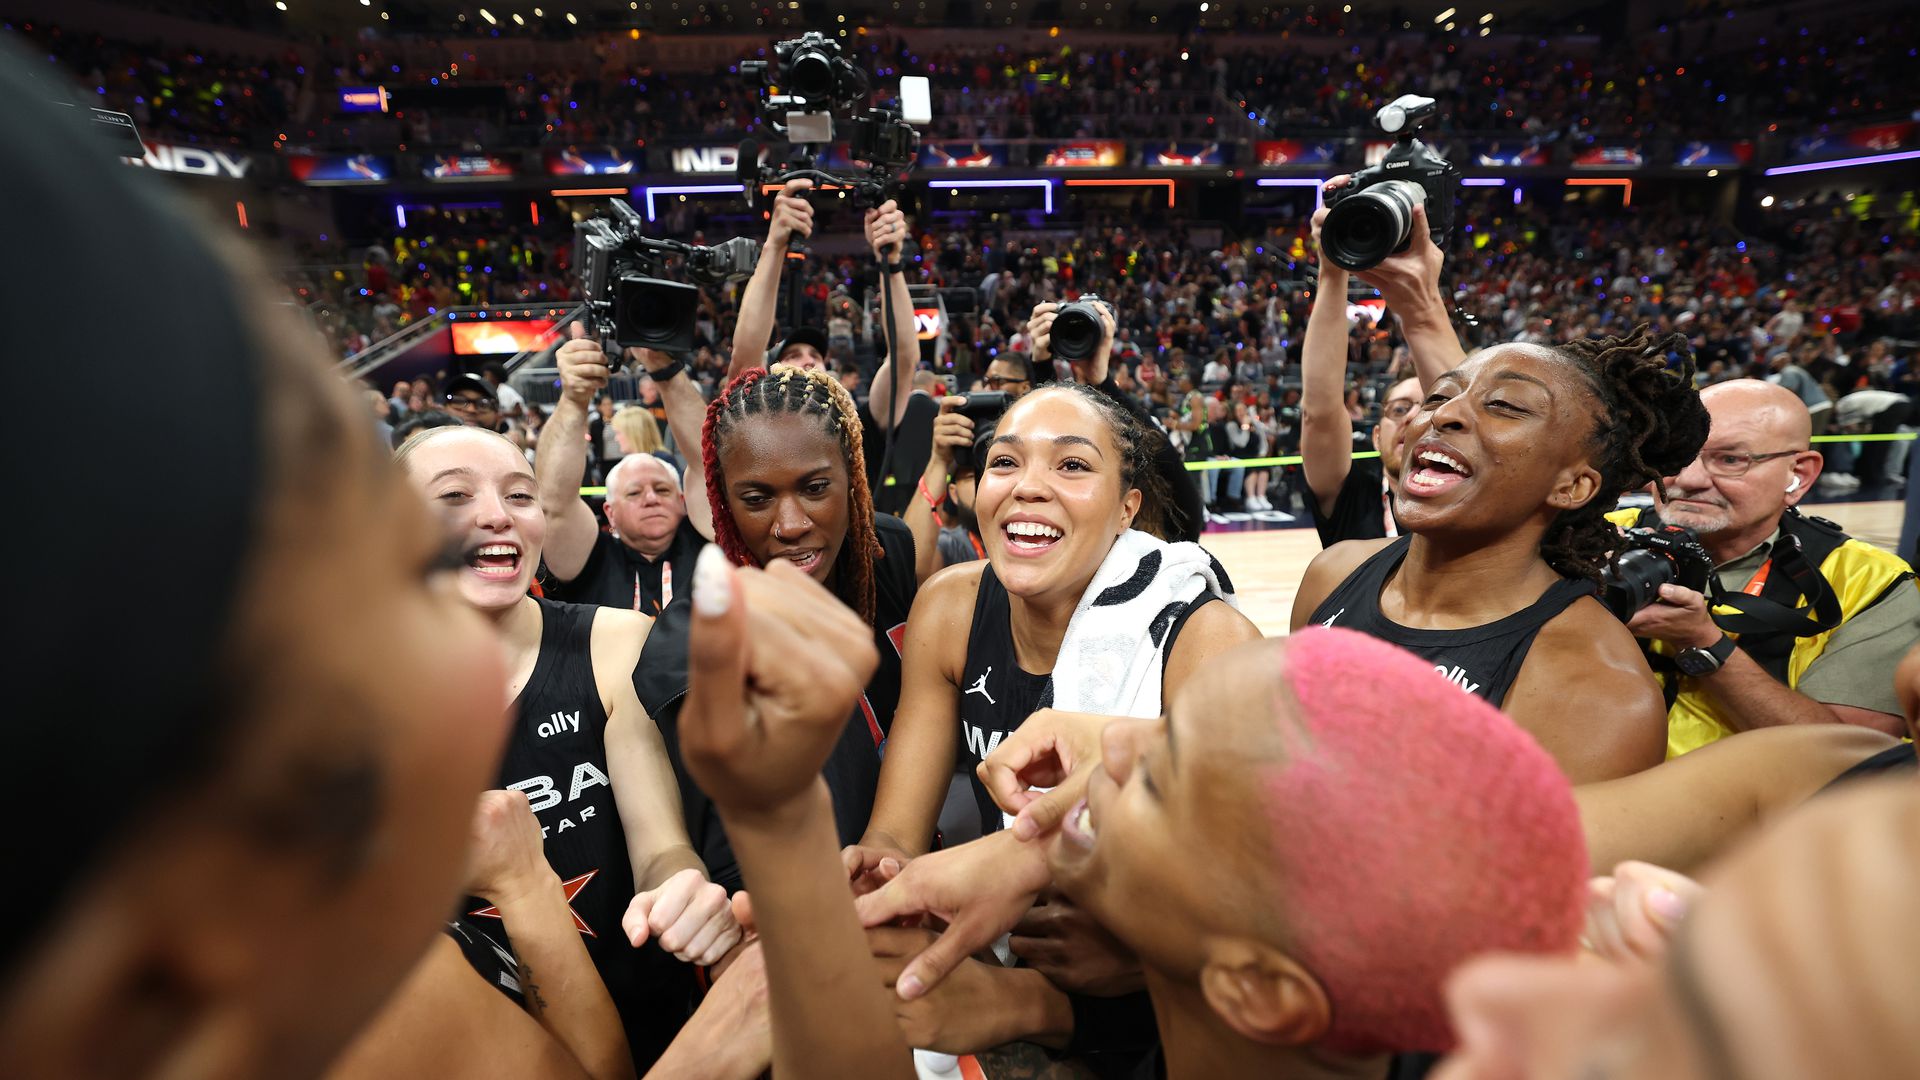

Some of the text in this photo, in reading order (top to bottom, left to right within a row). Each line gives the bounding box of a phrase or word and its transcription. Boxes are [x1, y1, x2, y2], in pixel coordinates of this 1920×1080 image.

[118, 145, 253, 179] NDY
[1650, 537, 1671, 545] SONY
[537, 710, 580, 738] ally
[963, 720, 1014, 760] W
